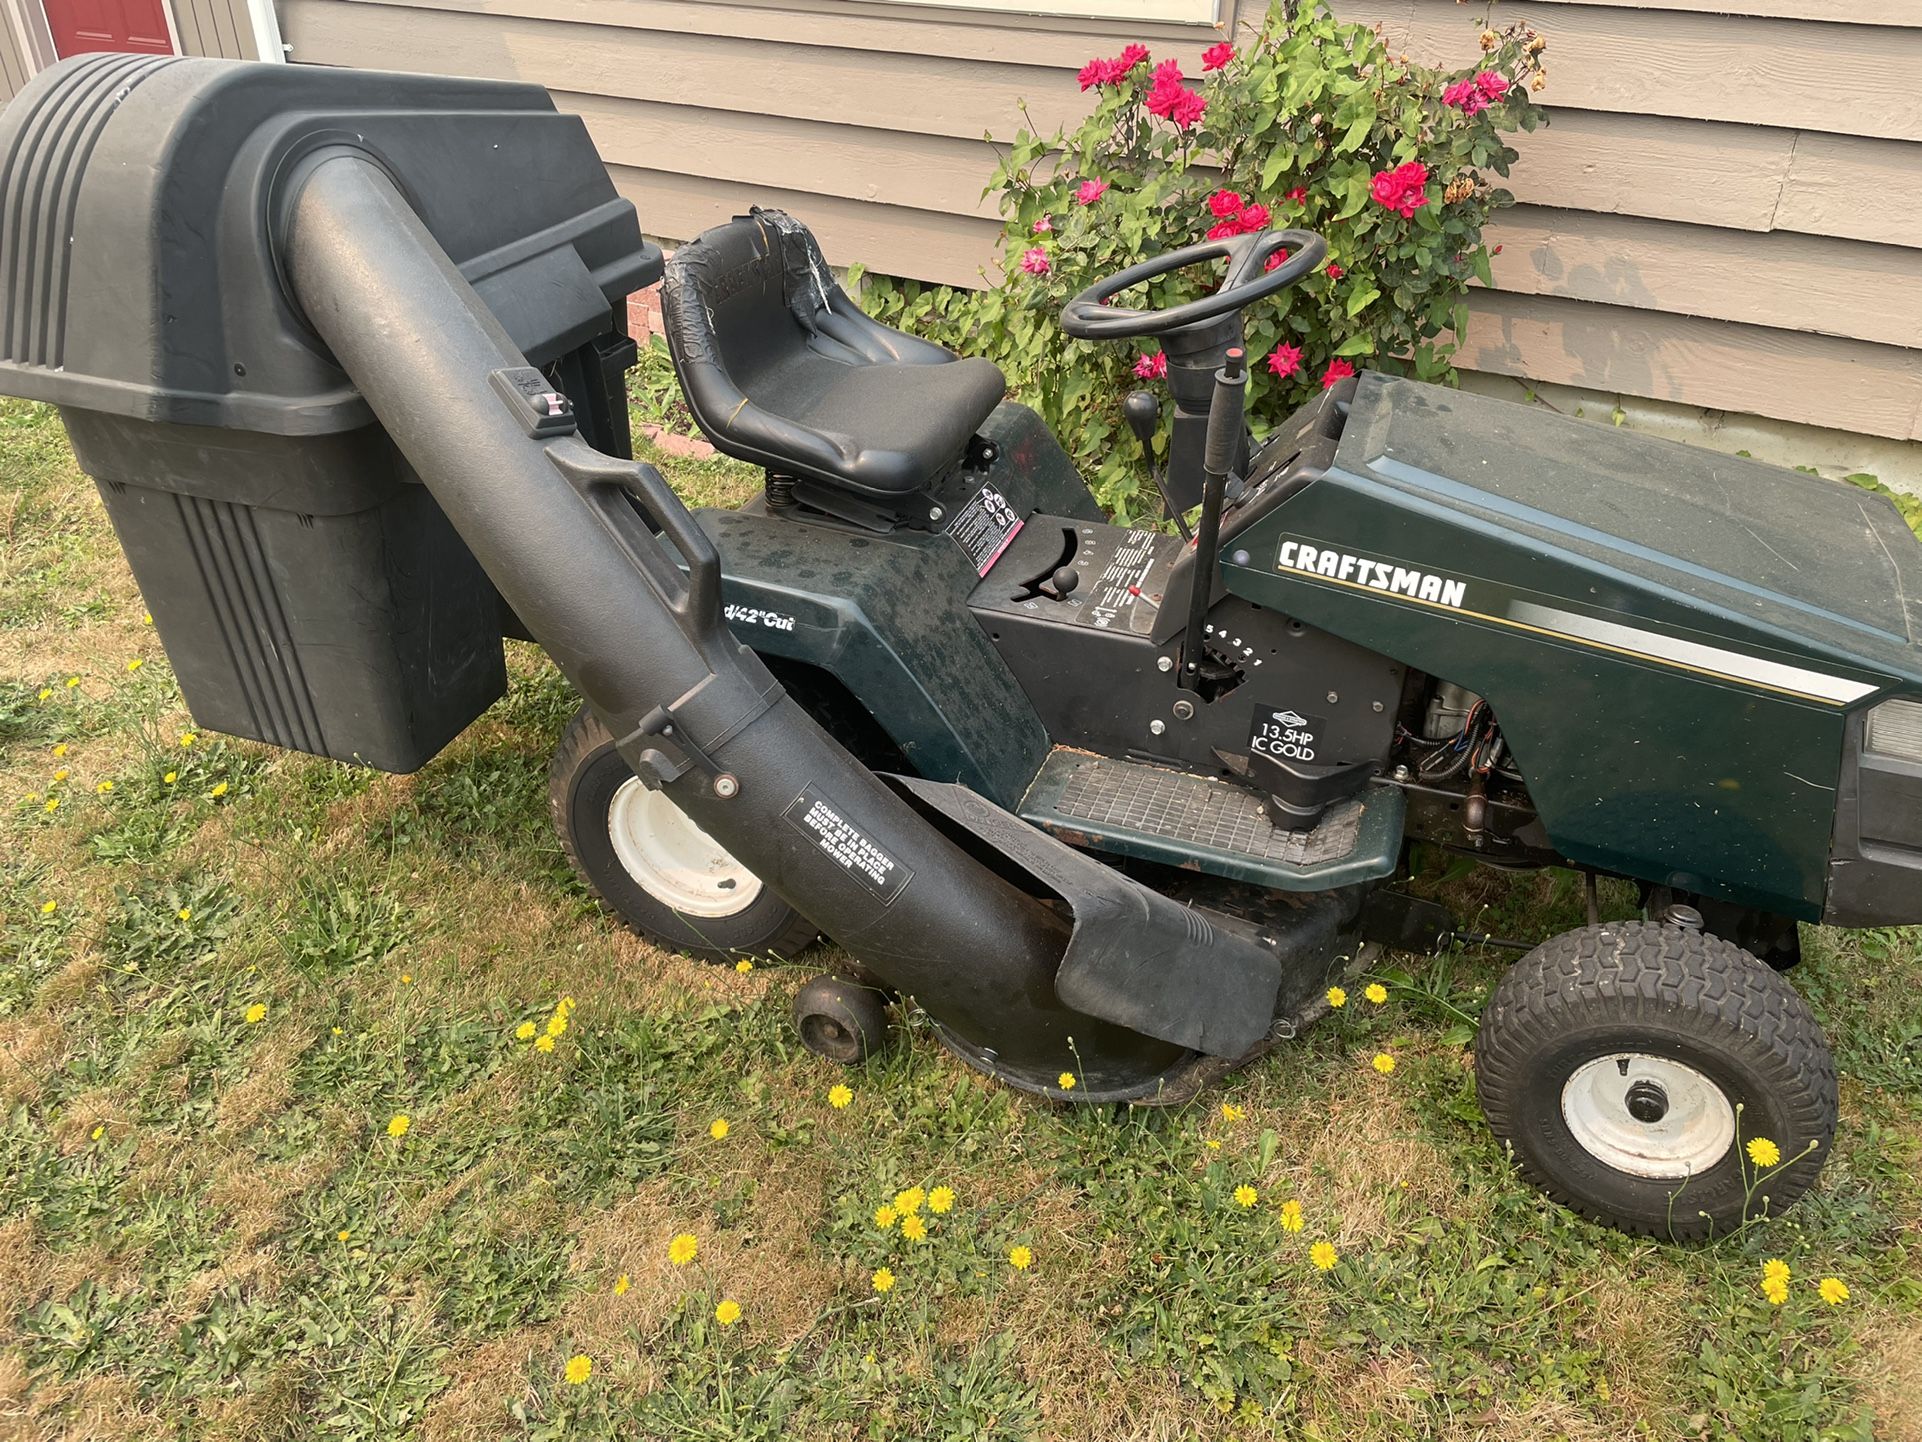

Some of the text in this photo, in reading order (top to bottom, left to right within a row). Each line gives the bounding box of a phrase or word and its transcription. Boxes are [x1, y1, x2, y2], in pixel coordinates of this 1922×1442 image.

[1279, 541, 1467, 608] CRAFTSMAN
[1218, 629, 1227, 639] 4
[1233, 638, 1242, 647] 3
[1243, 647, 1254, 656] 2
[1251, 735, 1315, 761] IC GOLD
[1261, 723, 1314, 746] 13.5HP
[803, 813, 886, 885] BEFORE OPERATING
[808, 807, 887, 875] MUST BE IN PLACE
[814, 800, 895, 871] COMPLETE BAGGER
[819, 838, 853, 869] MOWER
